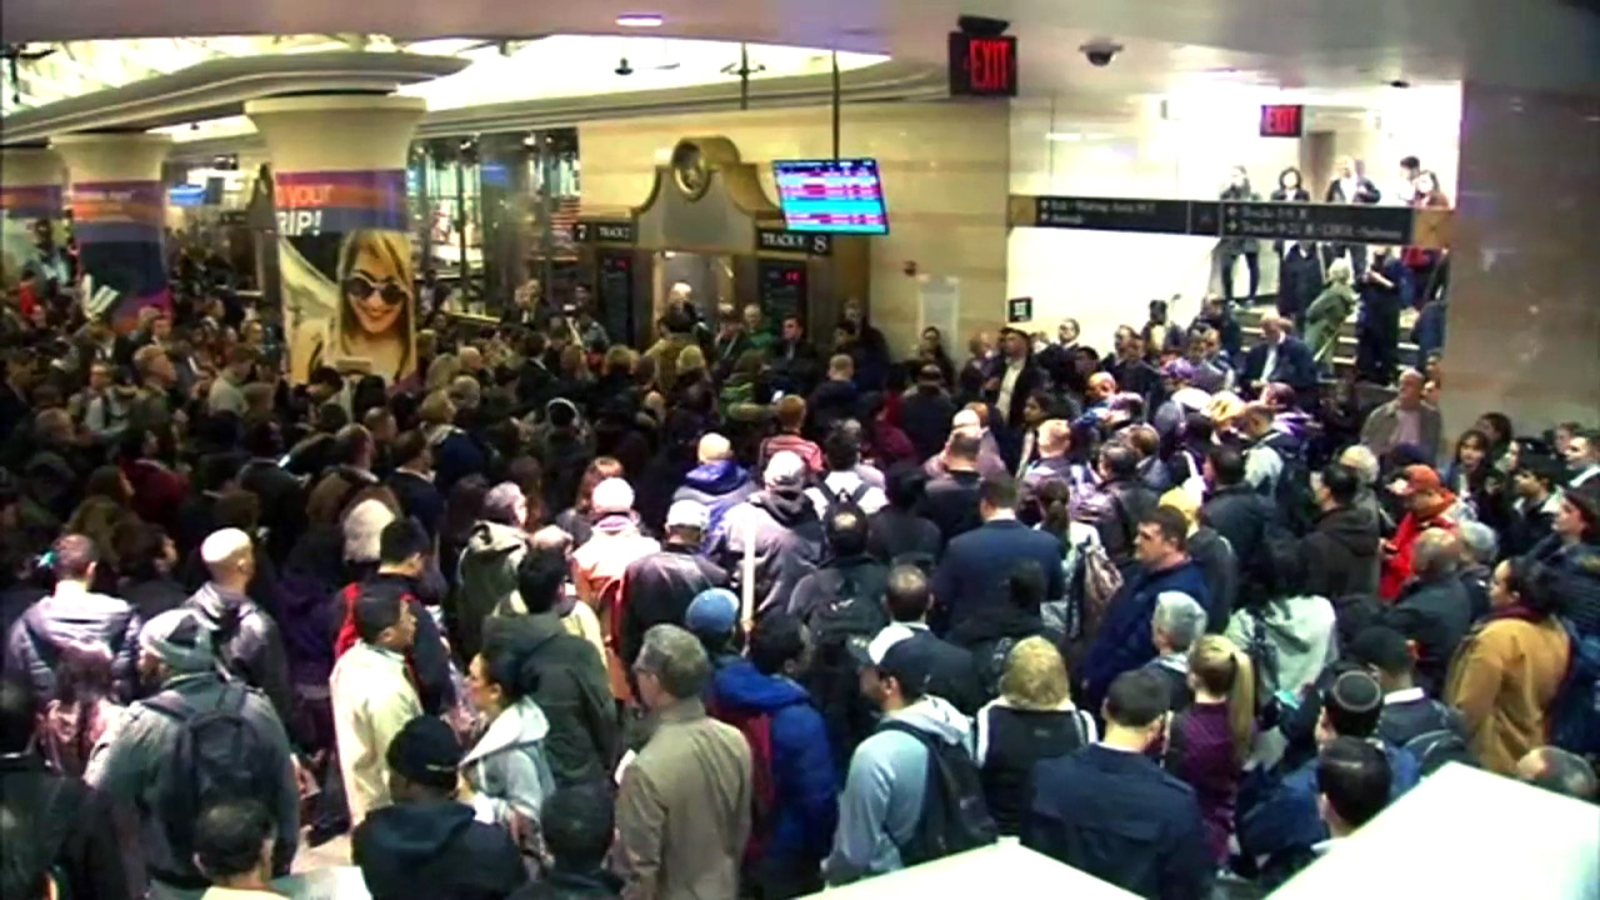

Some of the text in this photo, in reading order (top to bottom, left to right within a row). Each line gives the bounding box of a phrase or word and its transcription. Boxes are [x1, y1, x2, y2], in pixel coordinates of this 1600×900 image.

[970, 38, 1009, 91] EXIT
[1265, 107, 1296, 133] EXIT
[577, 224, 587, 240] 7
[762, 232, 796, 246] TRACK
[814, 235, 828, 253] 8
